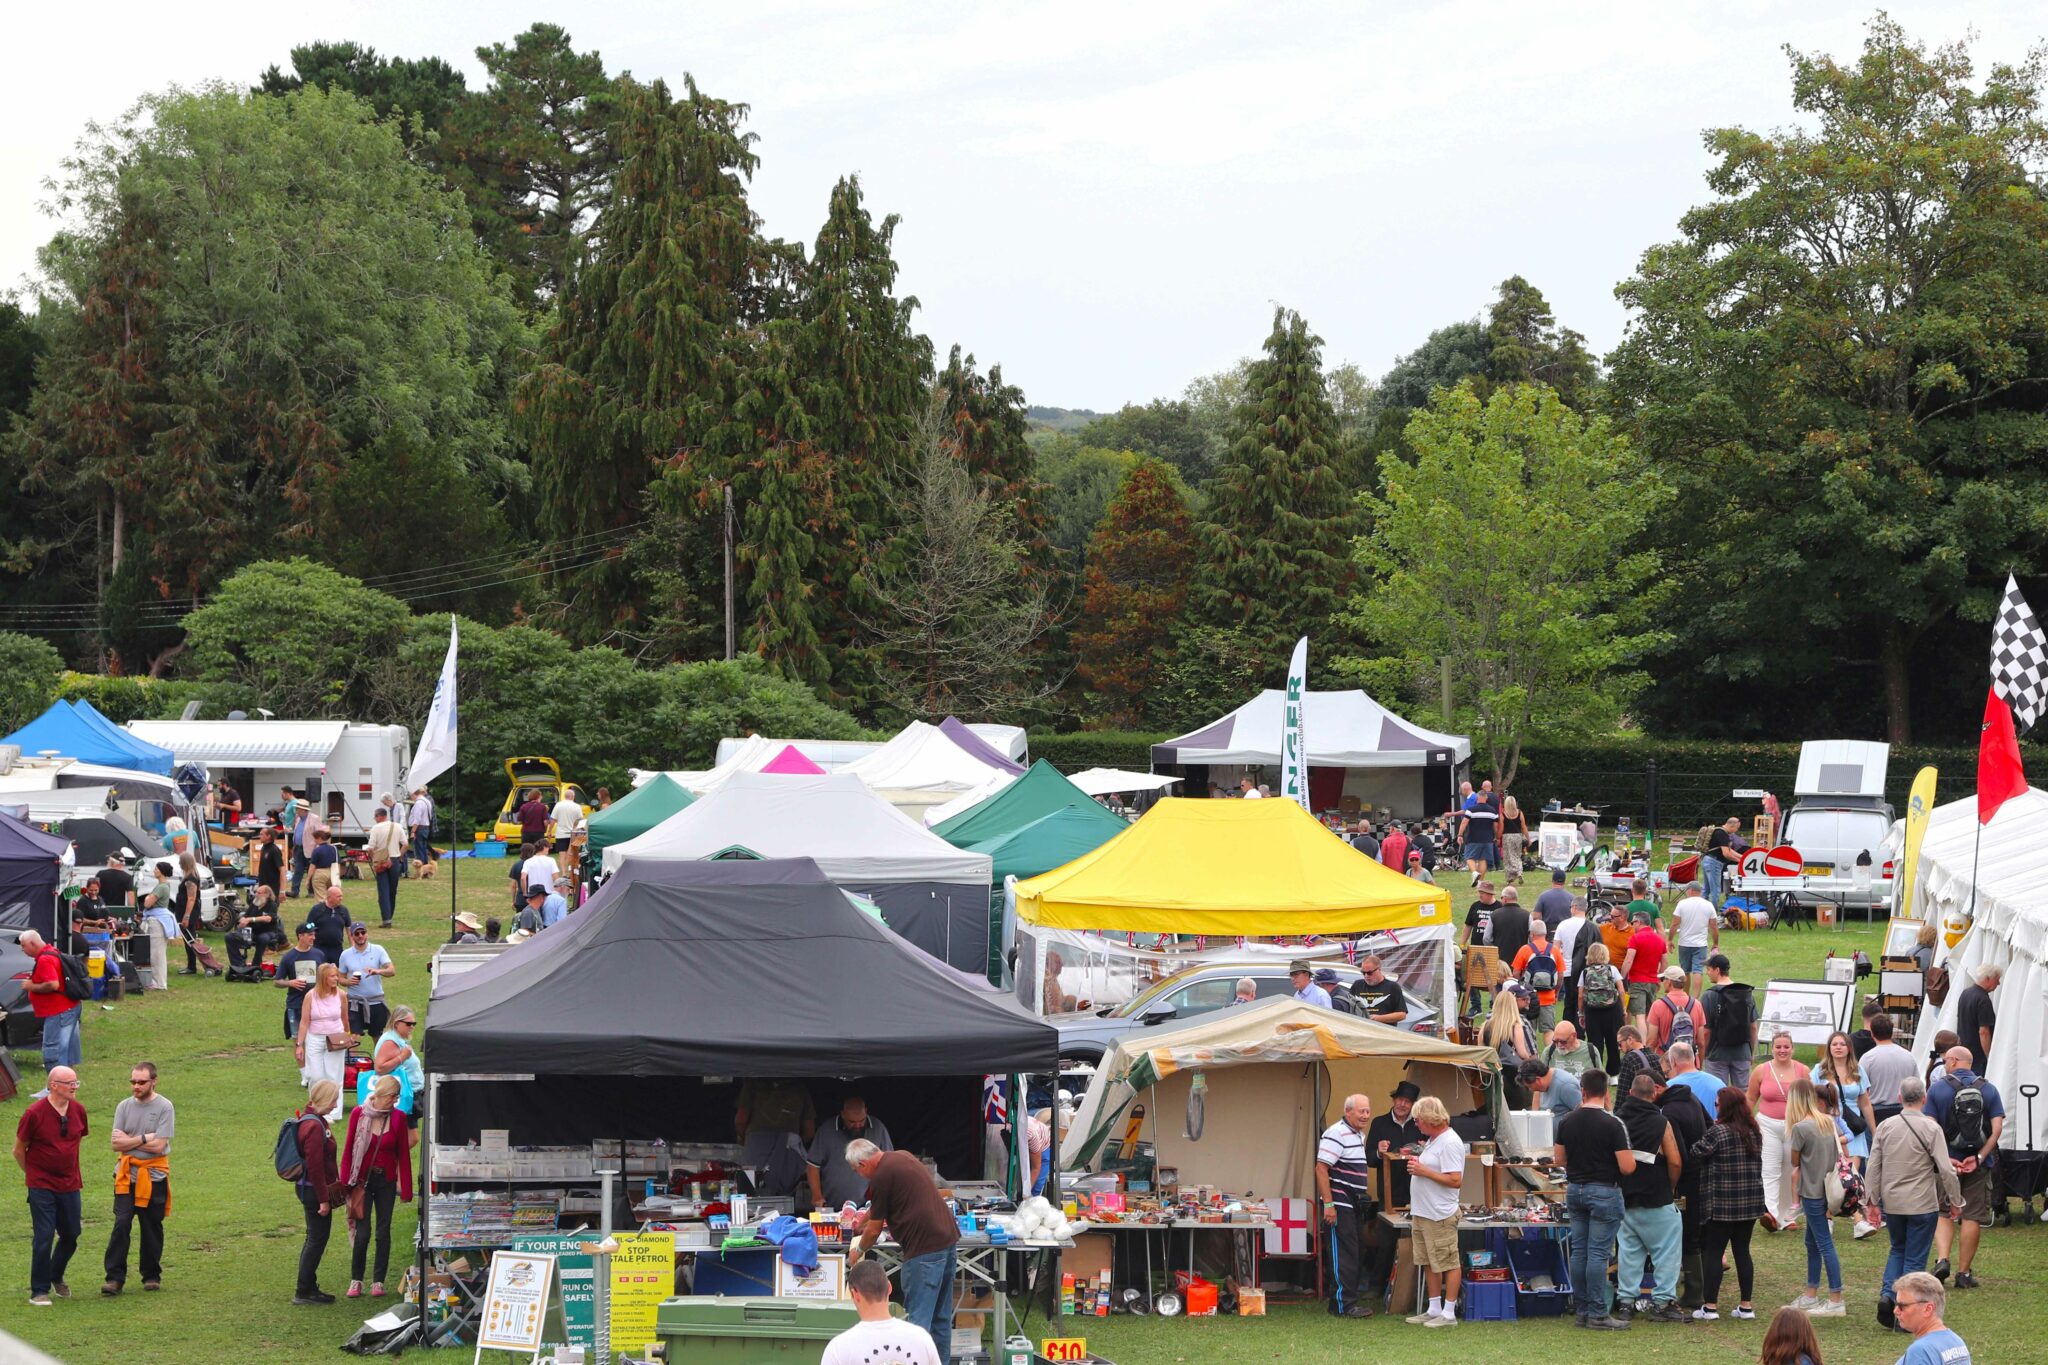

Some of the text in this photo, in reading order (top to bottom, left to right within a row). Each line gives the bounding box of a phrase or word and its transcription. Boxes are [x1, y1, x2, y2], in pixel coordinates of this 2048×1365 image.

[1286, 676, 1302, 802] NGER
[514, 1241, 524, 1251] IF
[527, 1241, 557, 1251] YOUR
[636, 1255, 669, 1263] PETROL
[1047, 1342, 1081, 1361] £10
